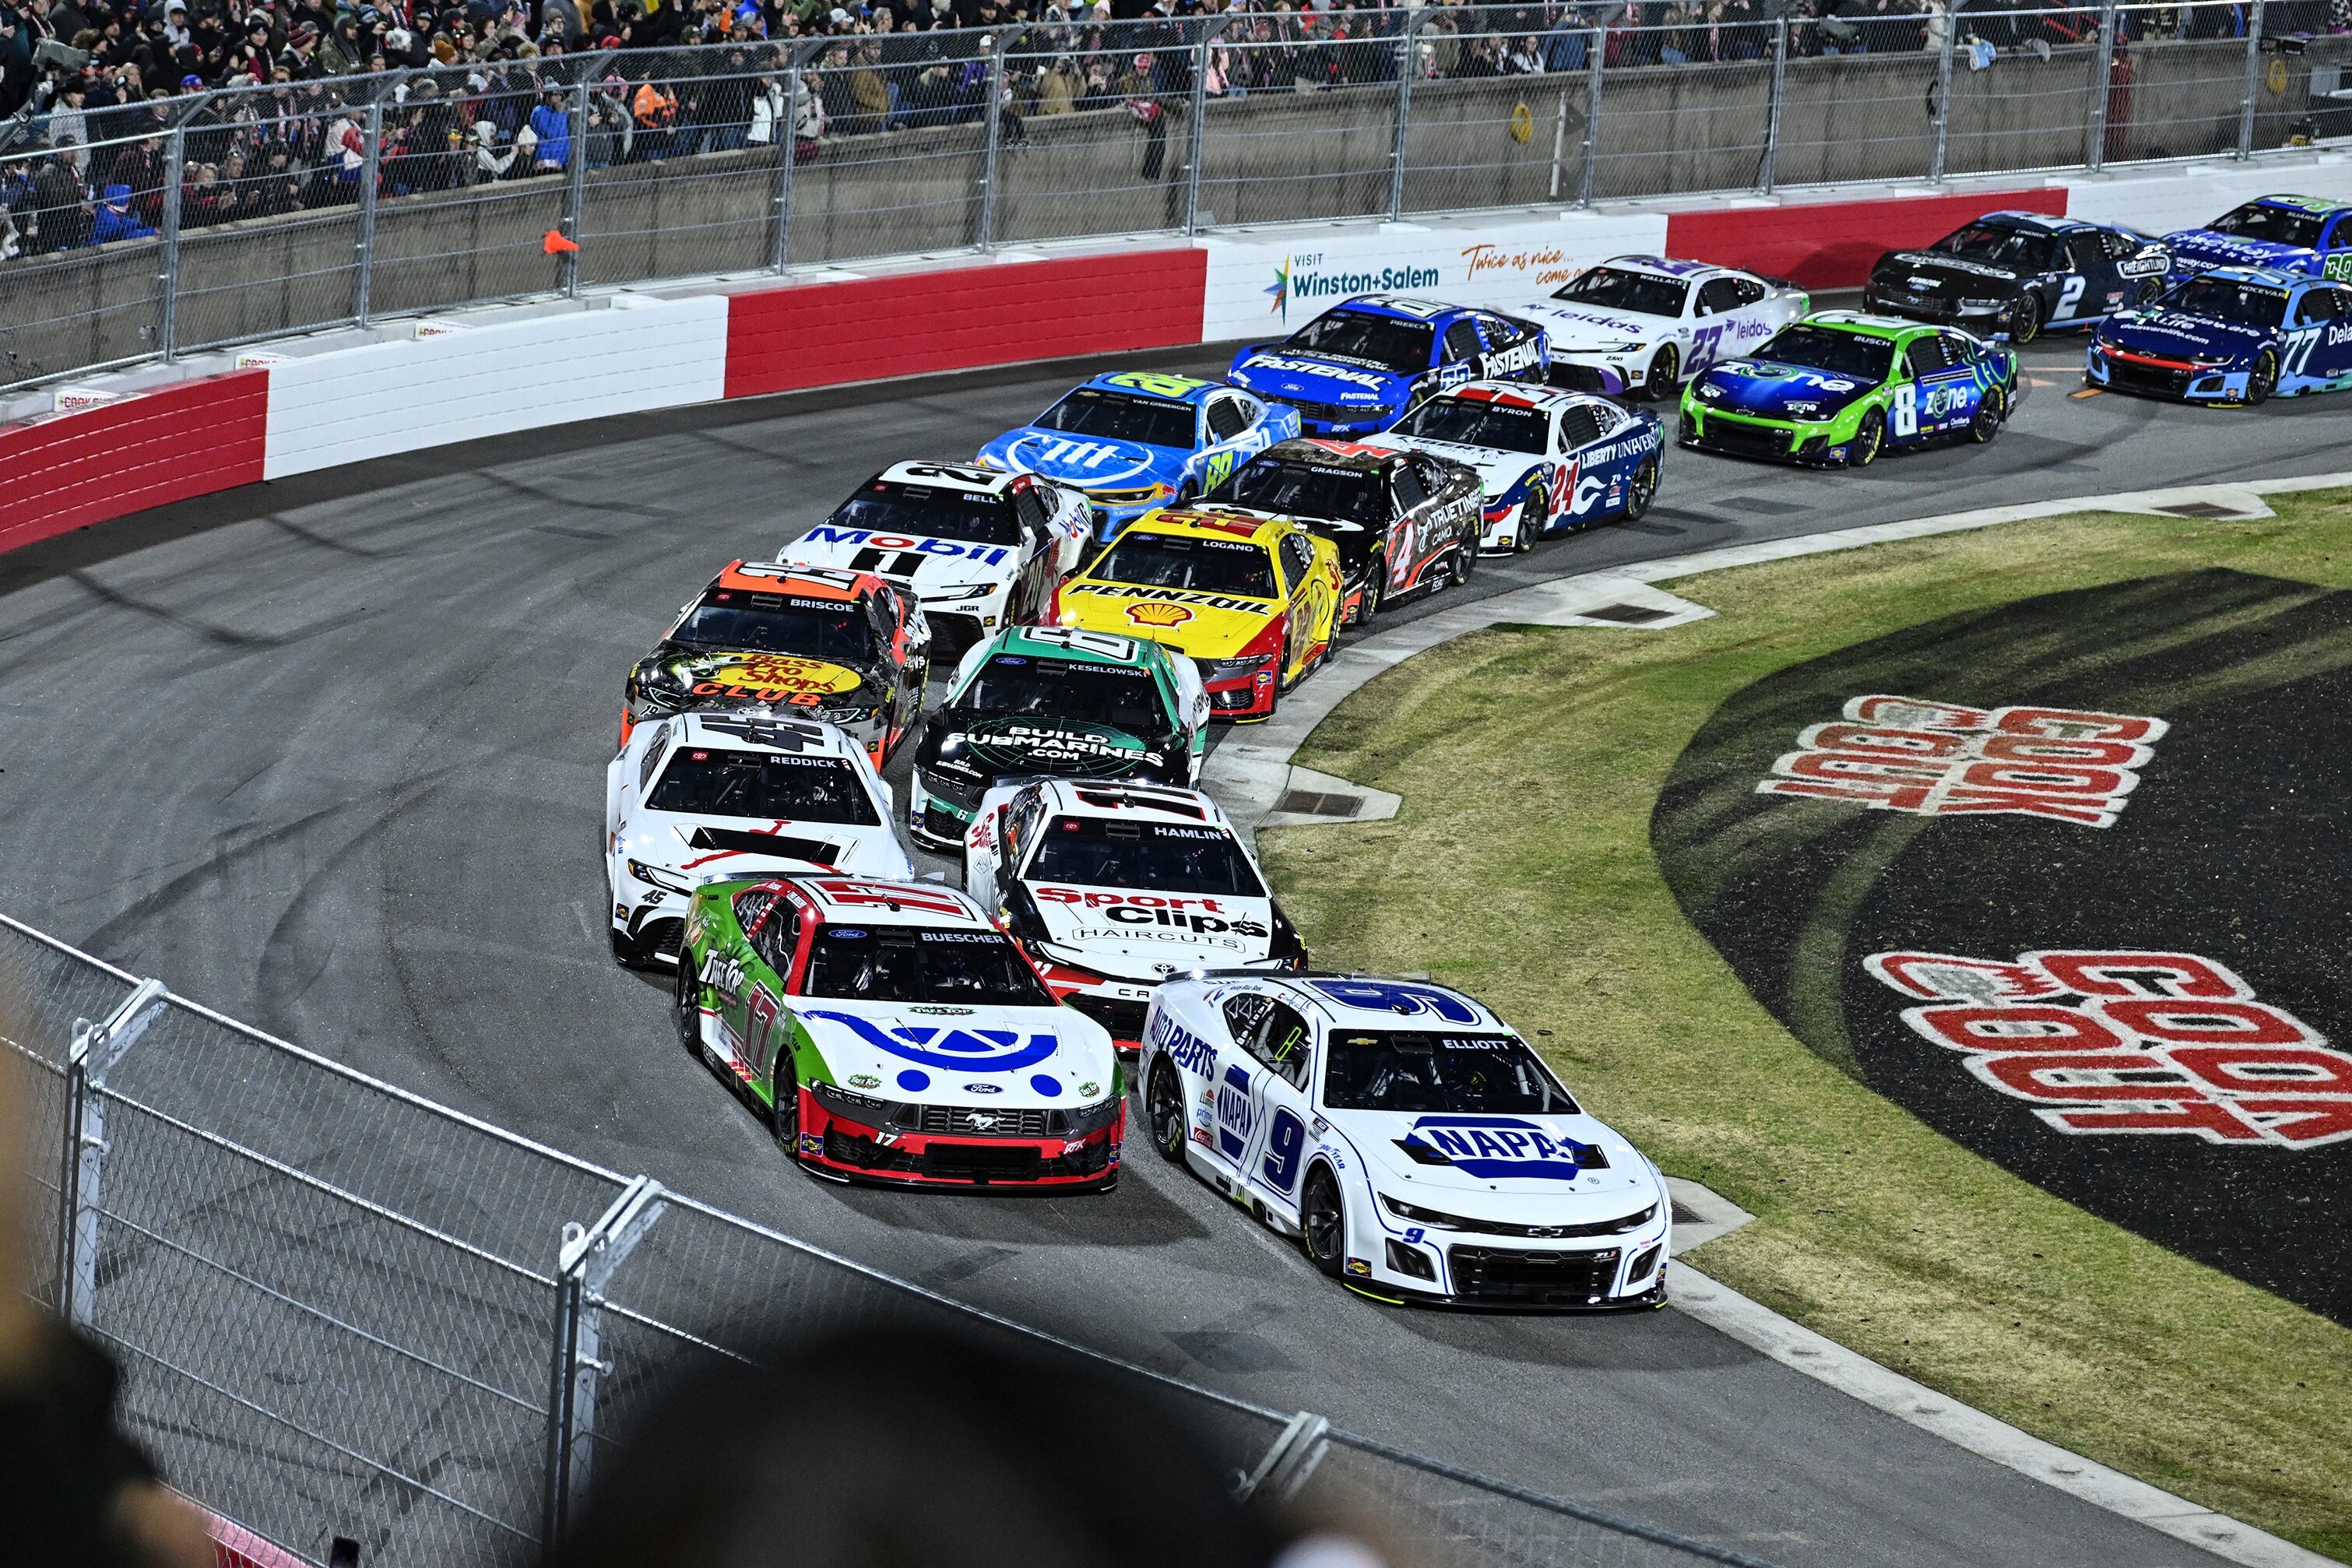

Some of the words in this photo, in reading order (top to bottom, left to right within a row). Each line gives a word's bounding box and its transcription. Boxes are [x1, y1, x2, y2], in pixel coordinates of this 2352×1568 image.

[1294, 253, 1324, 267] VISIT
[1461, 244, 1510, 281] Twice
[1511, 254, 1526, 270] as
[1293, 265, 1439, 297] Winston+Salem
[1535, 269, 1569, 284] come
[2051, 276, 2087, 322] 2
[1389, 319, 1427, 331] PREECE
[1549, 310, 1644, 334] leidos
[1736, 318, 1773, 339] leidos
[1853, 335, 1892, 347] BUSCH
[1682, 325, 1724, 376] 23
[2280, 327, 2323, 379] 77
[1239, 353, 1387, 391] FASTENAL
[1340, 392, 1380, 401] FASTENAL
[1150, 401, 1192, 411] GISBERGEN
[1492, 406, 1532, 418] BYRON
[1895, 382, 1918, 437] 8
[1580, 445, 1618, 470] LIBERTY
[1310, 466, 1362, 479] GRAGSON
[1549, 461, 1580, 515] 24
[962, 493, 997, 504] BELL
[804, 527, 1010, 567] Mobil
[1202, 540, 1254, 552] LOGANO
[1392, 522, 1415, 586] 4
[789, 598, 855, 613] BRISCOE
[955, 604, 979, 613] JGR
[1066, 583, 1273, 617] PENNZOIL
[746, 653, 824, 669] Bass
[1068, 663, 1148, 678] KESELOWSKI
[737, 670, 835, 692] Shops
[691, 682, 823, 707] CLUB
[1008, 726, 1110, 744] BUILD
[946, 732, 1164, 768] SUBMARINES
[1026, 749, 1080, 761] .COM
[770, 756, 838, 769] REDDICK
[953, 759, 971, 768] BUILD
[1937, 705, 2171, 829] COOK
[956, 810, 969, 821] 6
[1154, 827, 1222, 841] HAMLIN
[641, 889, 668, 905] 45
[1035, 887, 1225, 915] Sport
[1106, 905, 1269, 939] Clips
[831, 930, 863, 938] Ford
[921, 933, 1006, 944] BUESCHER
[1079, 928, 1239, 949] HAIRCUTS
[743, 979, 782, 1081] 17
[1443, 1039, 1510, 1049] ELLIOTT
[1167, 1024, 1218, 1082] PARTS
[967, 1084, 1000, 1094] Ford
[1196, 1107, 1213, 1121] prime
[1222, 1089, 1248, 1138] NAPA
[874, 1131, 898, 1146] 17
[1063, 1138, 1087, 1155] RFK
[1427, 1129, 1573, 1159] NAPA
[1263, 1105, 1307, 1196] 9
[1402, 1228, 1426, 1243] 9
